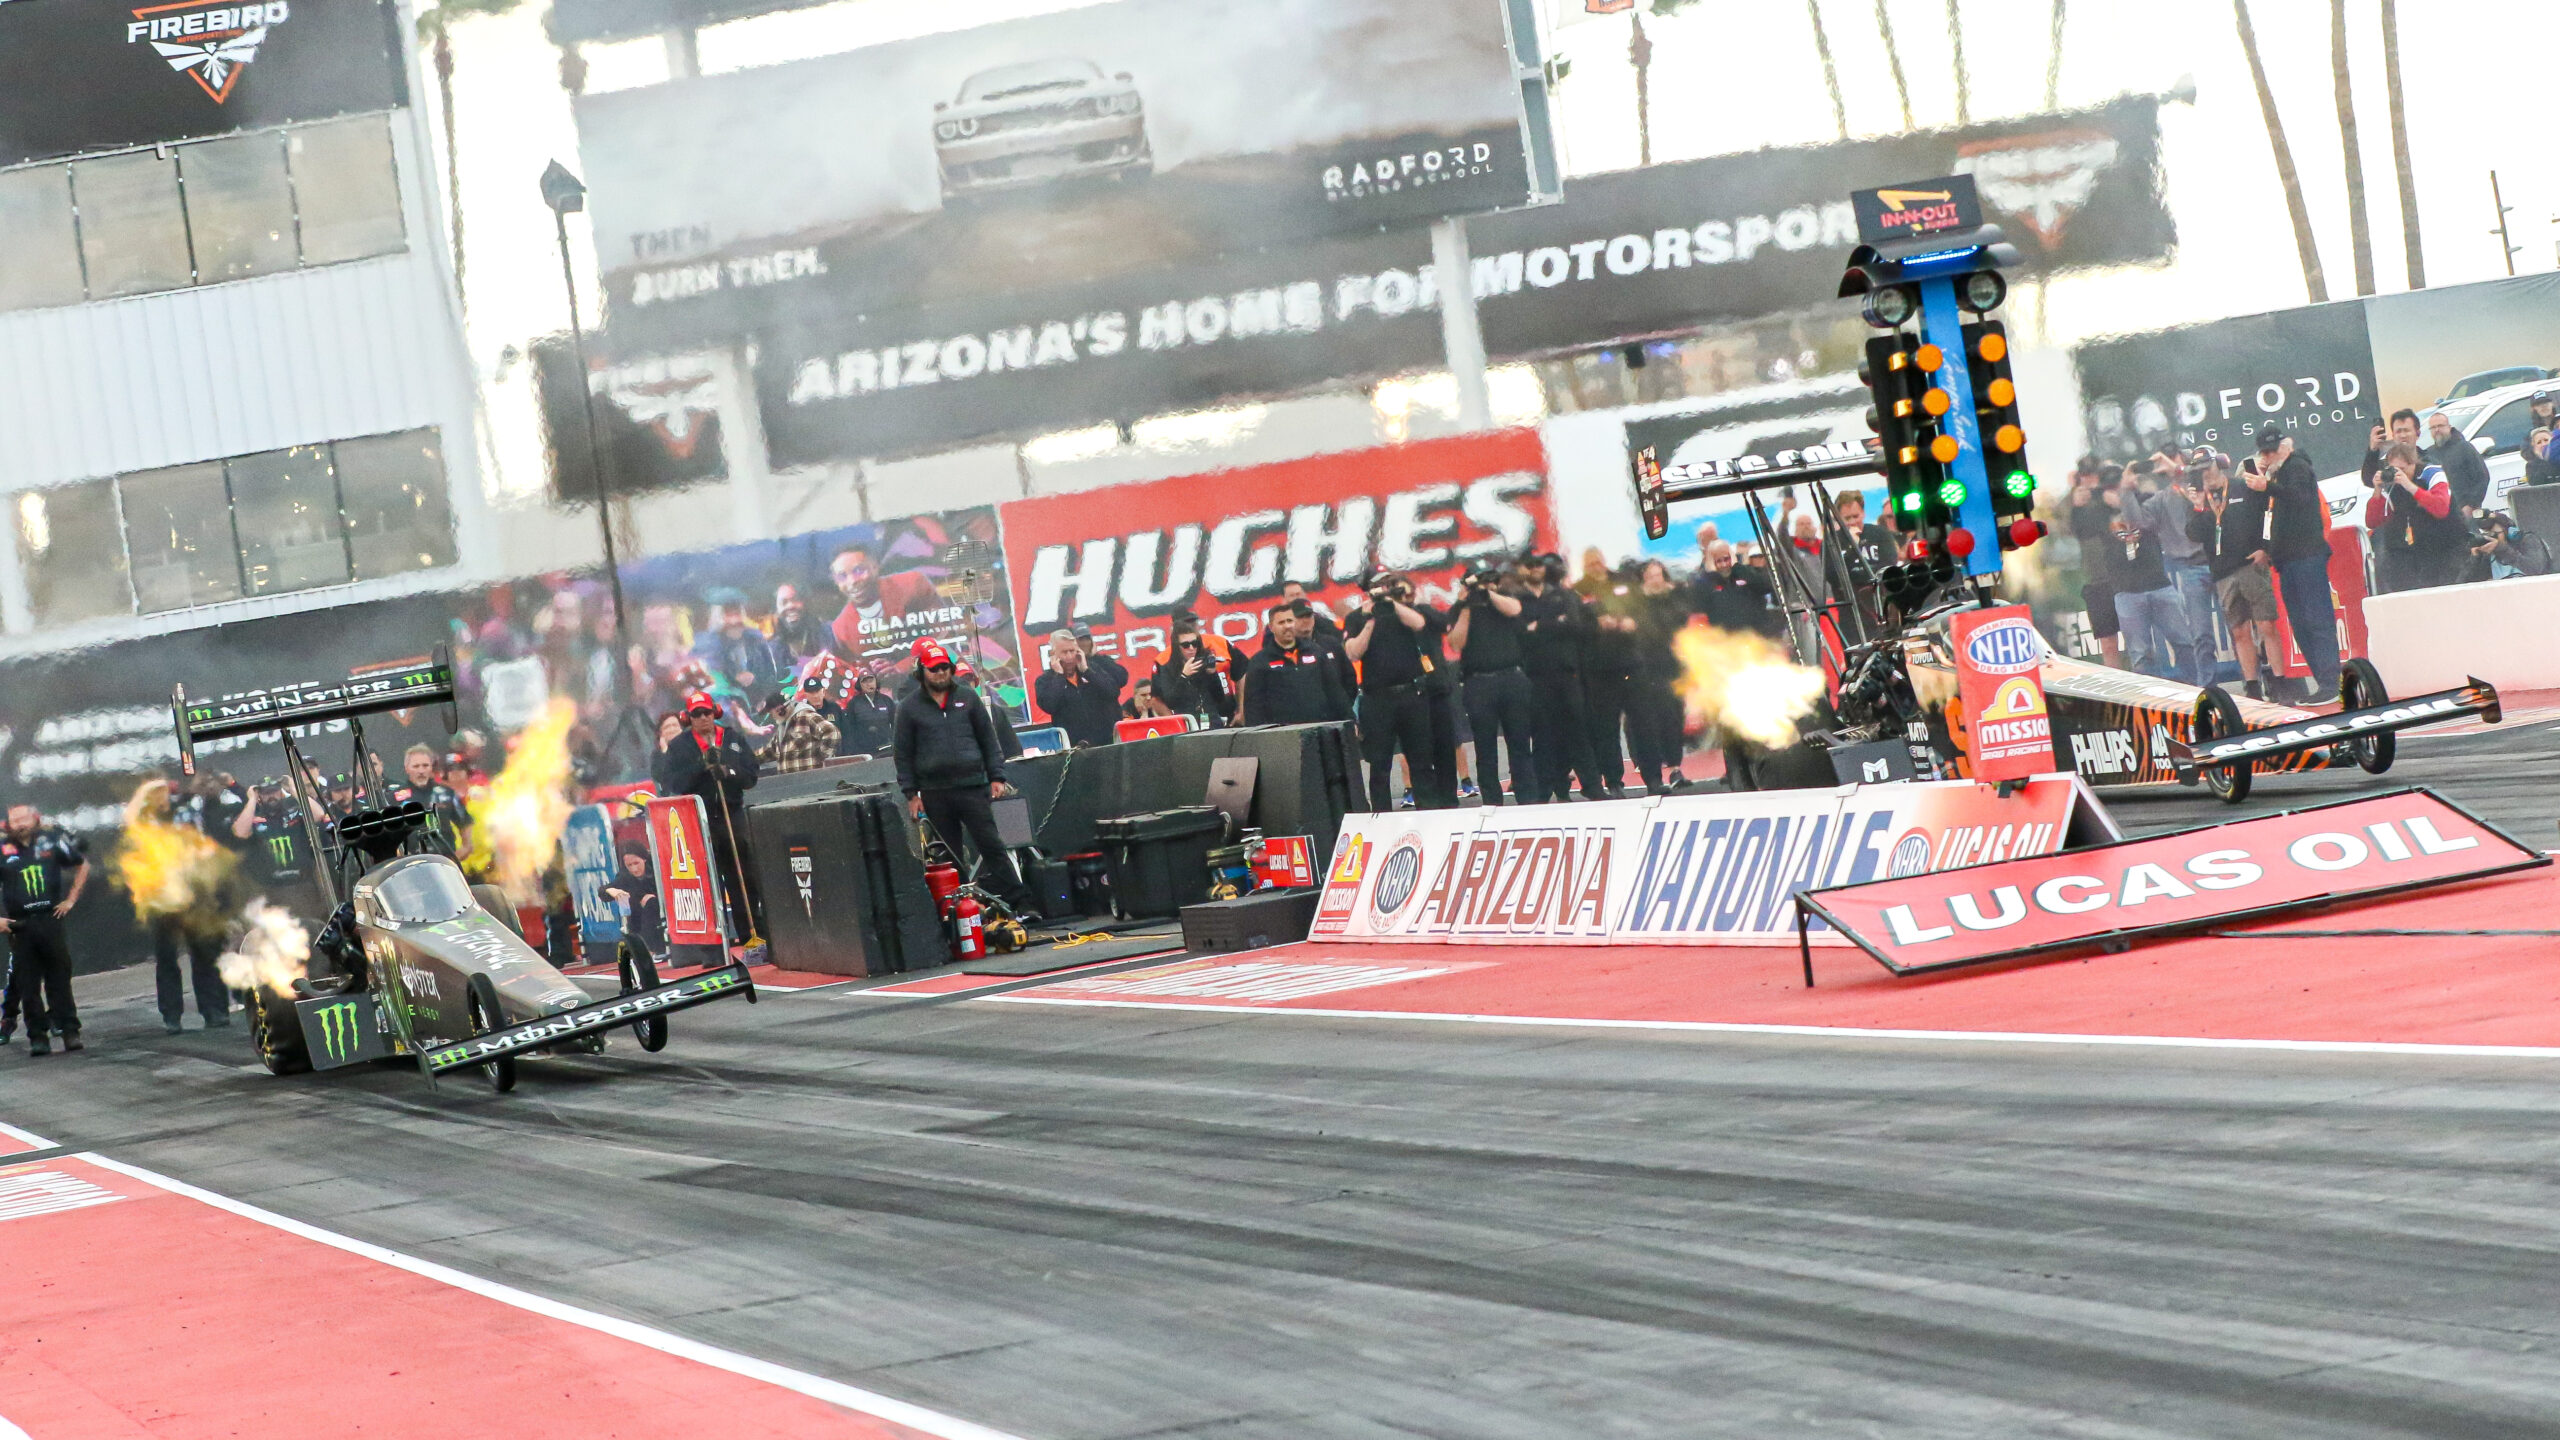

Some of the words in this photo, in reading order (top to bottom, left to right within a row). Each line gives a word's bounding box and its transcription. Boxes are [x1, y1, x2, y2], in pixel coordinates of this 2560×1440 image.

[127, 1, 289, 43] FIREBIRD
[1323, 143, 1490, 189] RADFORD
[1881, 203, 1957, 228] IN-N-OUT
[789, 310, 1127, 403] ARIZONA'S
[1138, 281, 1322, 350] HOME
[1470, 200, 1860, 299] MOTORSPOR
[1022, 470, 1543, 635] HUGHES
[857, 616, 904, 634] GILA
[906, 606, 963, 627] RIVER
[1912, 652, 1933, 665] TOYOTA
[1980, 663, 2007, 674] DRAG
[1907, 722, 1928, 742] KATO
[2070, 729, 2137, 775] PHILLIPS
[2154, 758, 2173, 770] TOO
[1892, 835, 1929, 877] NHRA
[1930, 824, 2013, 871] LUCAS
[2010, 822, 2053, 858] OIL
[1377, 846, 1418, 909] NHRA
[1407, 828, 1615, 935] ARIZONA
[1617, 810, 1893, 931] NATIONALS
[1886, 848, 2264, 946] LUCAS
[2288, 815, 2480, 872] OIL
[478, 988, 693, 1054] MONSTER
